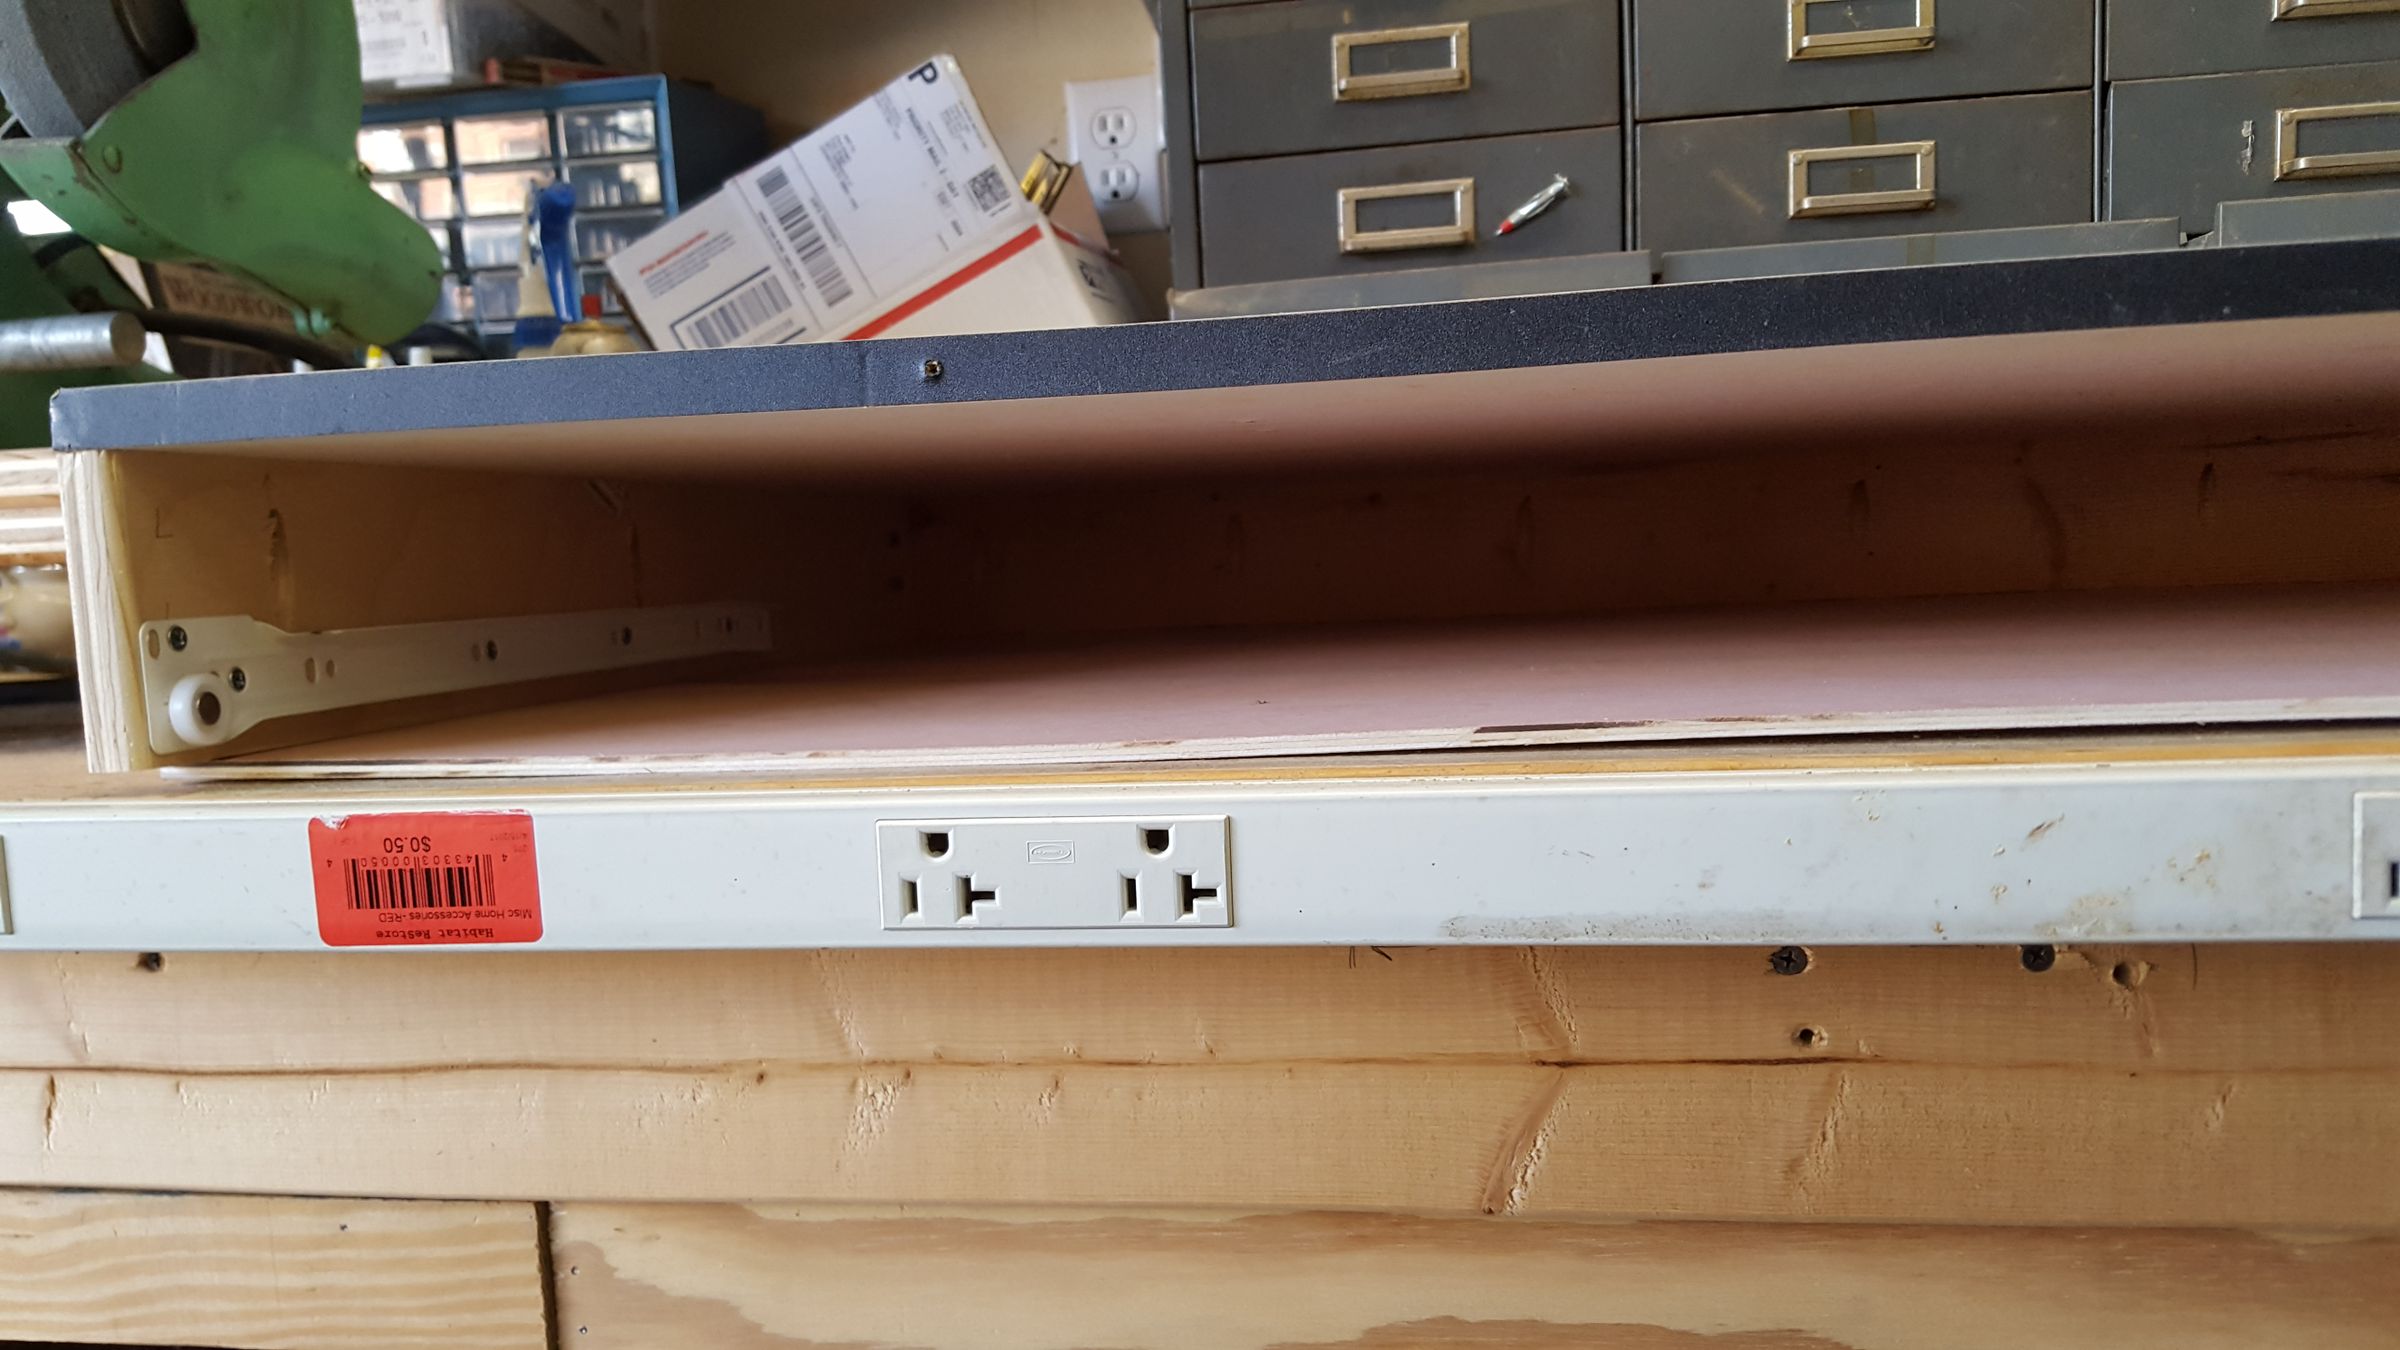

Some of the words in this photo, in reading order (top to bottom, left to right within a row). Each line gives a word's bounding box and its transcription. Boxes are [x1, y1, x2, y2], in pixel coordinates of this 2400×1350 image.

[908, 61, 939, 85] P
[383, 836, 431, 853] $0.50
[422, 854, 473, 865] 43303
[409, 910, 472, 920] Accessories
[475, 910, 504, 919] Home
[508, 908, 532, 919] Misc
[376, 929, 430, 940] ReStore
[440, 927, 494, 938] Habitat
